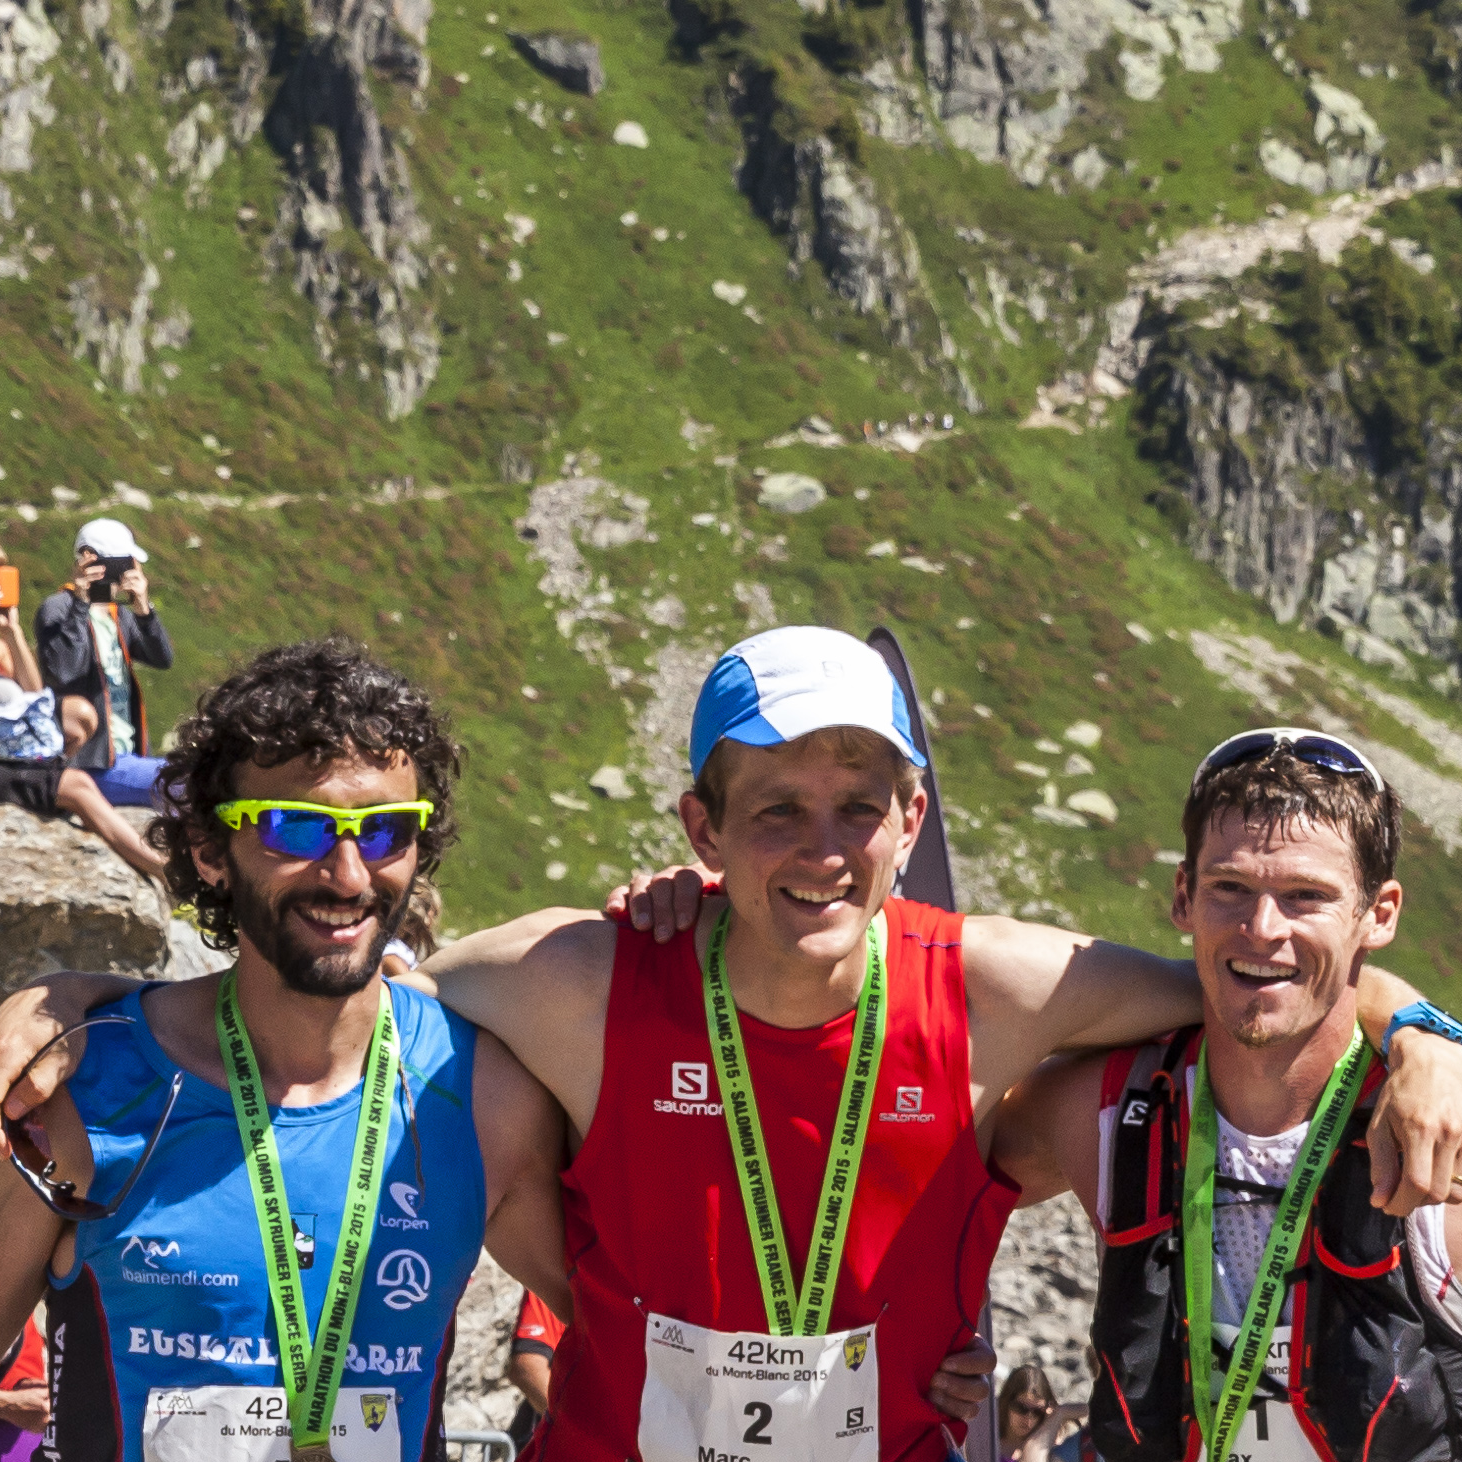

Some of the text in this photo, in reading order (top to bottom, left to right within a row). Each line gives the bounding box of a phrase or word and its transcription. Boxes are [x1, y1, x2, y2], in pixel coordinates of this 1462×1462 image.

[708, 951, 733, 1042] MONT-BLANC
[221, 1000, 252, 1082] MONT-BLANC
[720, 1044, 738, 1079] 2015
[855, 993, 880, 1078] SKYRUNNER
[240, 1083, 260, 1118] 2015
[369, 1044, 391, 1124] SKYRUNNER
[730, 1090, 758, 1158] SALOMON
[840, 1079, 867, 1147] SALOMON
[1306, 1088, 1348, 1167] SKYRUNNER
[250, 1128, 276, 1194] SALOMON
[357, 1125, 379, 1191] SALOMON
[830, 1158, 851, 1193] 2015
[349, 1203, 367, 1237] 2015
[380, 1214, 430, 1231] Lorpen
[745, 1159, 775, 1241] SKYRUNNER
[1281, 1167, 1315, 1234] SALOMON
[264, 1198, 292, 1282] SKYRUNNER
[812, 1195, 843, 1284] MONT-BLANC
[1266, 1240, 1289, 1281] 2015
[121, 1267, 239, 1287] ibaimendi.com
[329, 1239, 360, 1330] MONT-BLANC
[763, 1243, 787, 1298] FRANCE
[808, 1287, 825, 1307] DU
[280, 1285, 301, 1340] FRANCE
[1239, 1280, 1278, 1373] MONT-BLANC
[289, 1344, 308, 1394] SERIES
[324, 1332, 339, 1354] DU
[727, 1340, 805, 1365] 42km
[306, 1354, 336, 1433] MARATHON
[705, 1365, 828, 1382] du Mont-Blanc 2015
[1231, 1376, 1249, 1392] DU
[221, 1425, 236, 1436] du
[742, 1401, 773, 1446] 2
